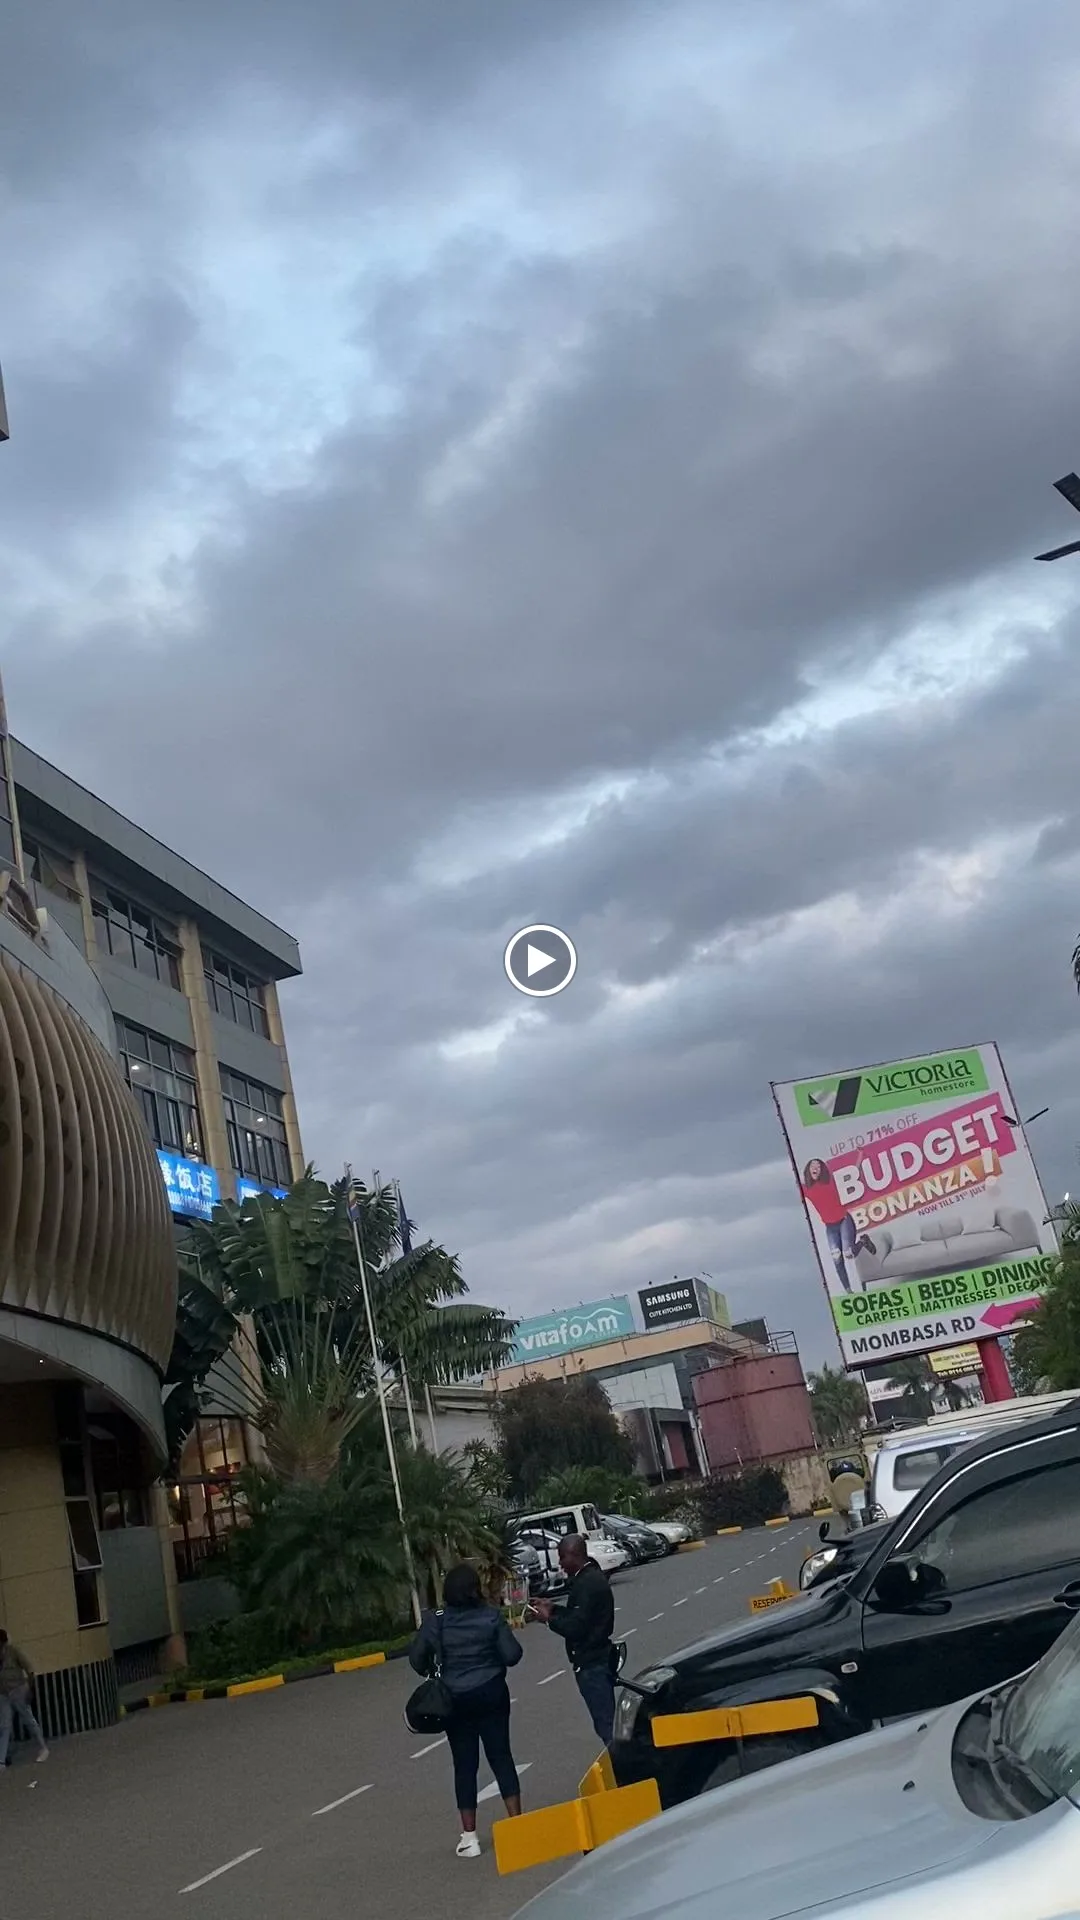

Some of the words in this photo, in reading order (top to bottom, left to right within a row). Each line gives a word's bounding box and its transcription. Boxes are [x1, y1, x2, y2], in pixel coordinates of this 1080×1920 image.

[920, 1080, 975, 1097] homestore
[829, 1142, 846, 1157] UP
[847, 1134, 865, 1150] TO
[866, 1124, 895, 1143] 71%
[896, 1112, 921, 1129] OFF
[832, 1104, 999, 1206] BUDGET
[918, 1204, 938, 1216] NOW
[939, 1198, 955, 1209] TILL
[969, 1184, 987, 1198] JULY
[645, 1289, 690, 1307] SAMSUNG
[841, 1288, 904, 1317] SOFAS
[917, 1275, 968, 1302] BEDS
[981, 1256, 1052, 1288] DINING
[649, 1308, 662, 1318] CUTE
[662, 1304, 683, 1316] KITCHEN
[683, 1302, 693, 1311] LTD
[856, 1306, 910, 1326] CARPETS
[919, 1288, 997, 1313] MATTRESSES
[851, 1322, 948, 1354] MOMBASA
[951, 1315, 976, 1334] RD
